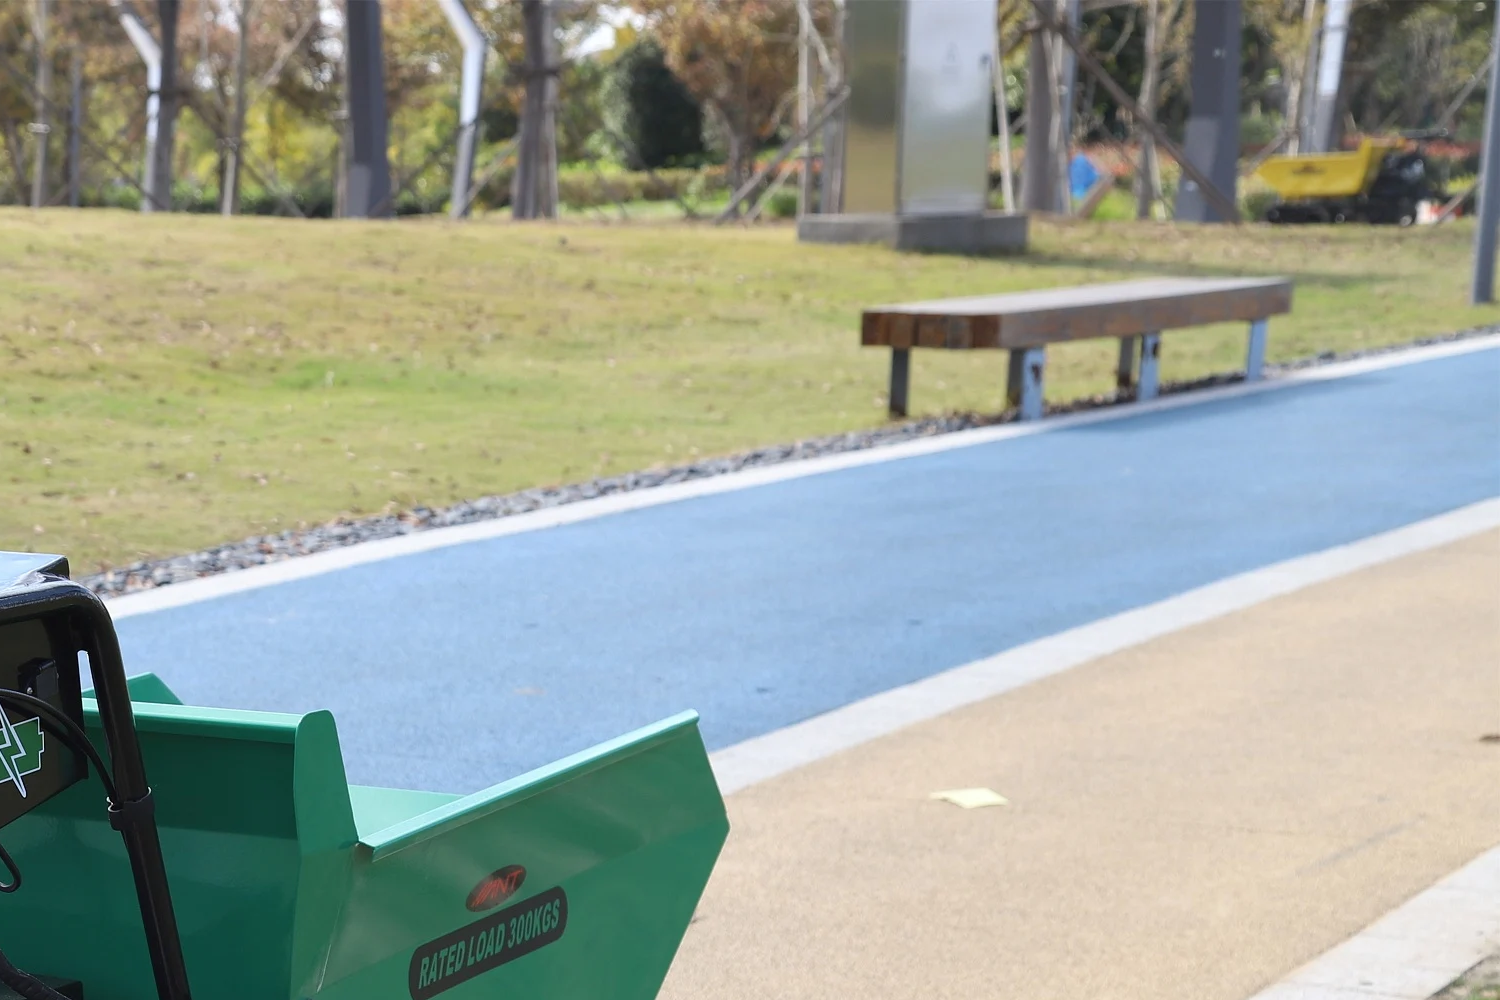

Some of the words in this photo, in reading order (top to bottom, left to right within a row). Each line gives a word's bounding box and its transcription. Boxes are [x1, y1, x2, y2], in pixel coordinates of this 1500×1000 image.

[418, 940, 466, 989] RATED
[466, 923, 505, 967] LOAD
[507, 899, 560, 949] 300KGS
